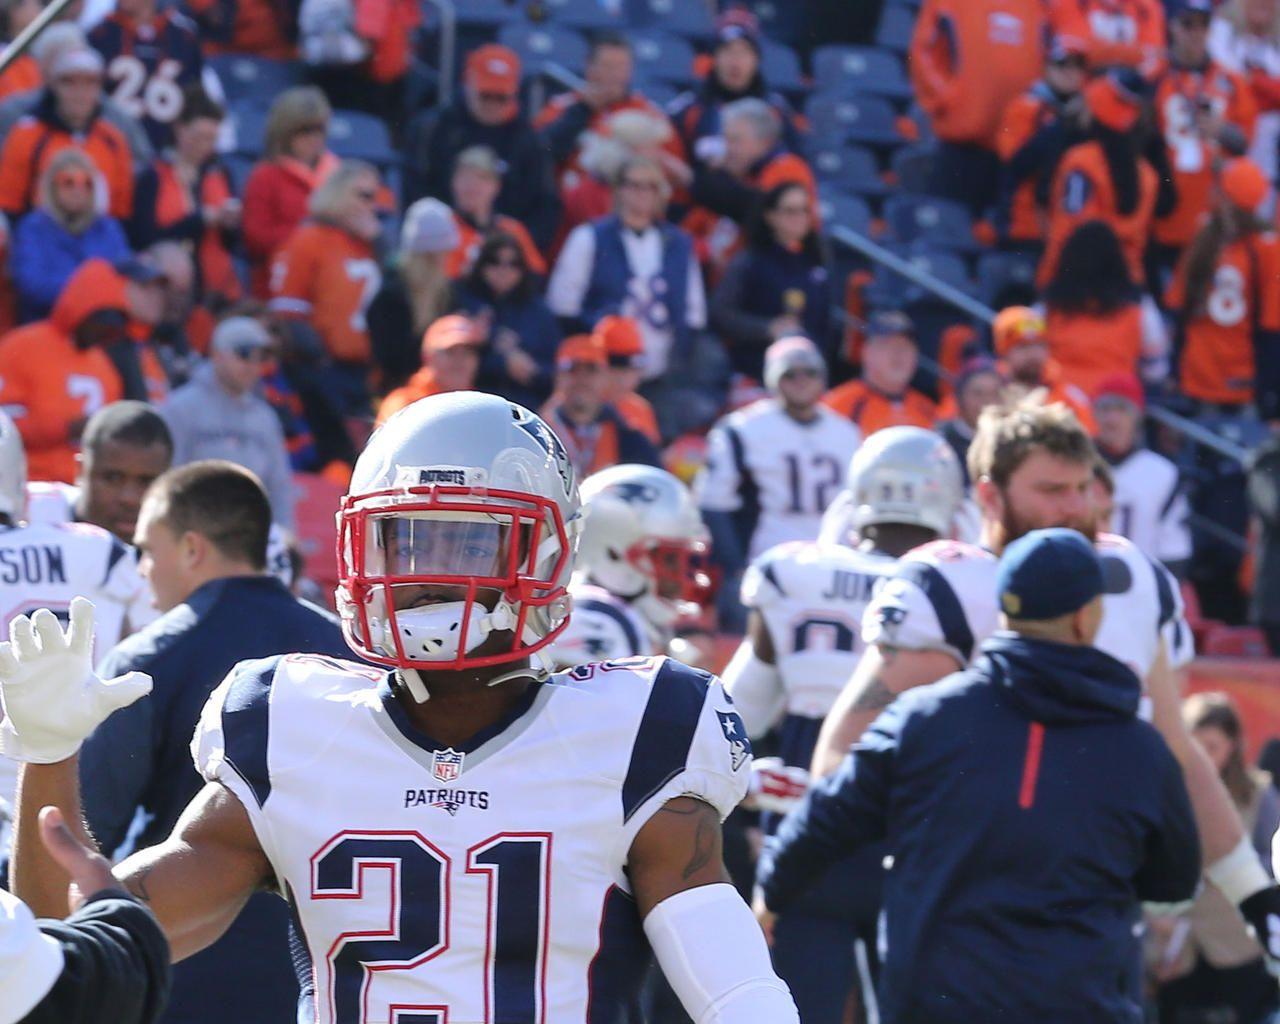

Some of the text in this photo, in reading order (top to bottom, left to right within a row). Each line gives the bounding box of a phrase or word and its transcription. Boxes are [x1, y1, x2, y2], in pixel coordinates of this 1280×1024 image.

[108, 55, 183, 122] 26
[434, 763, 459, 779] NFL
[404, 788, 490, 810] PATRIOTS
